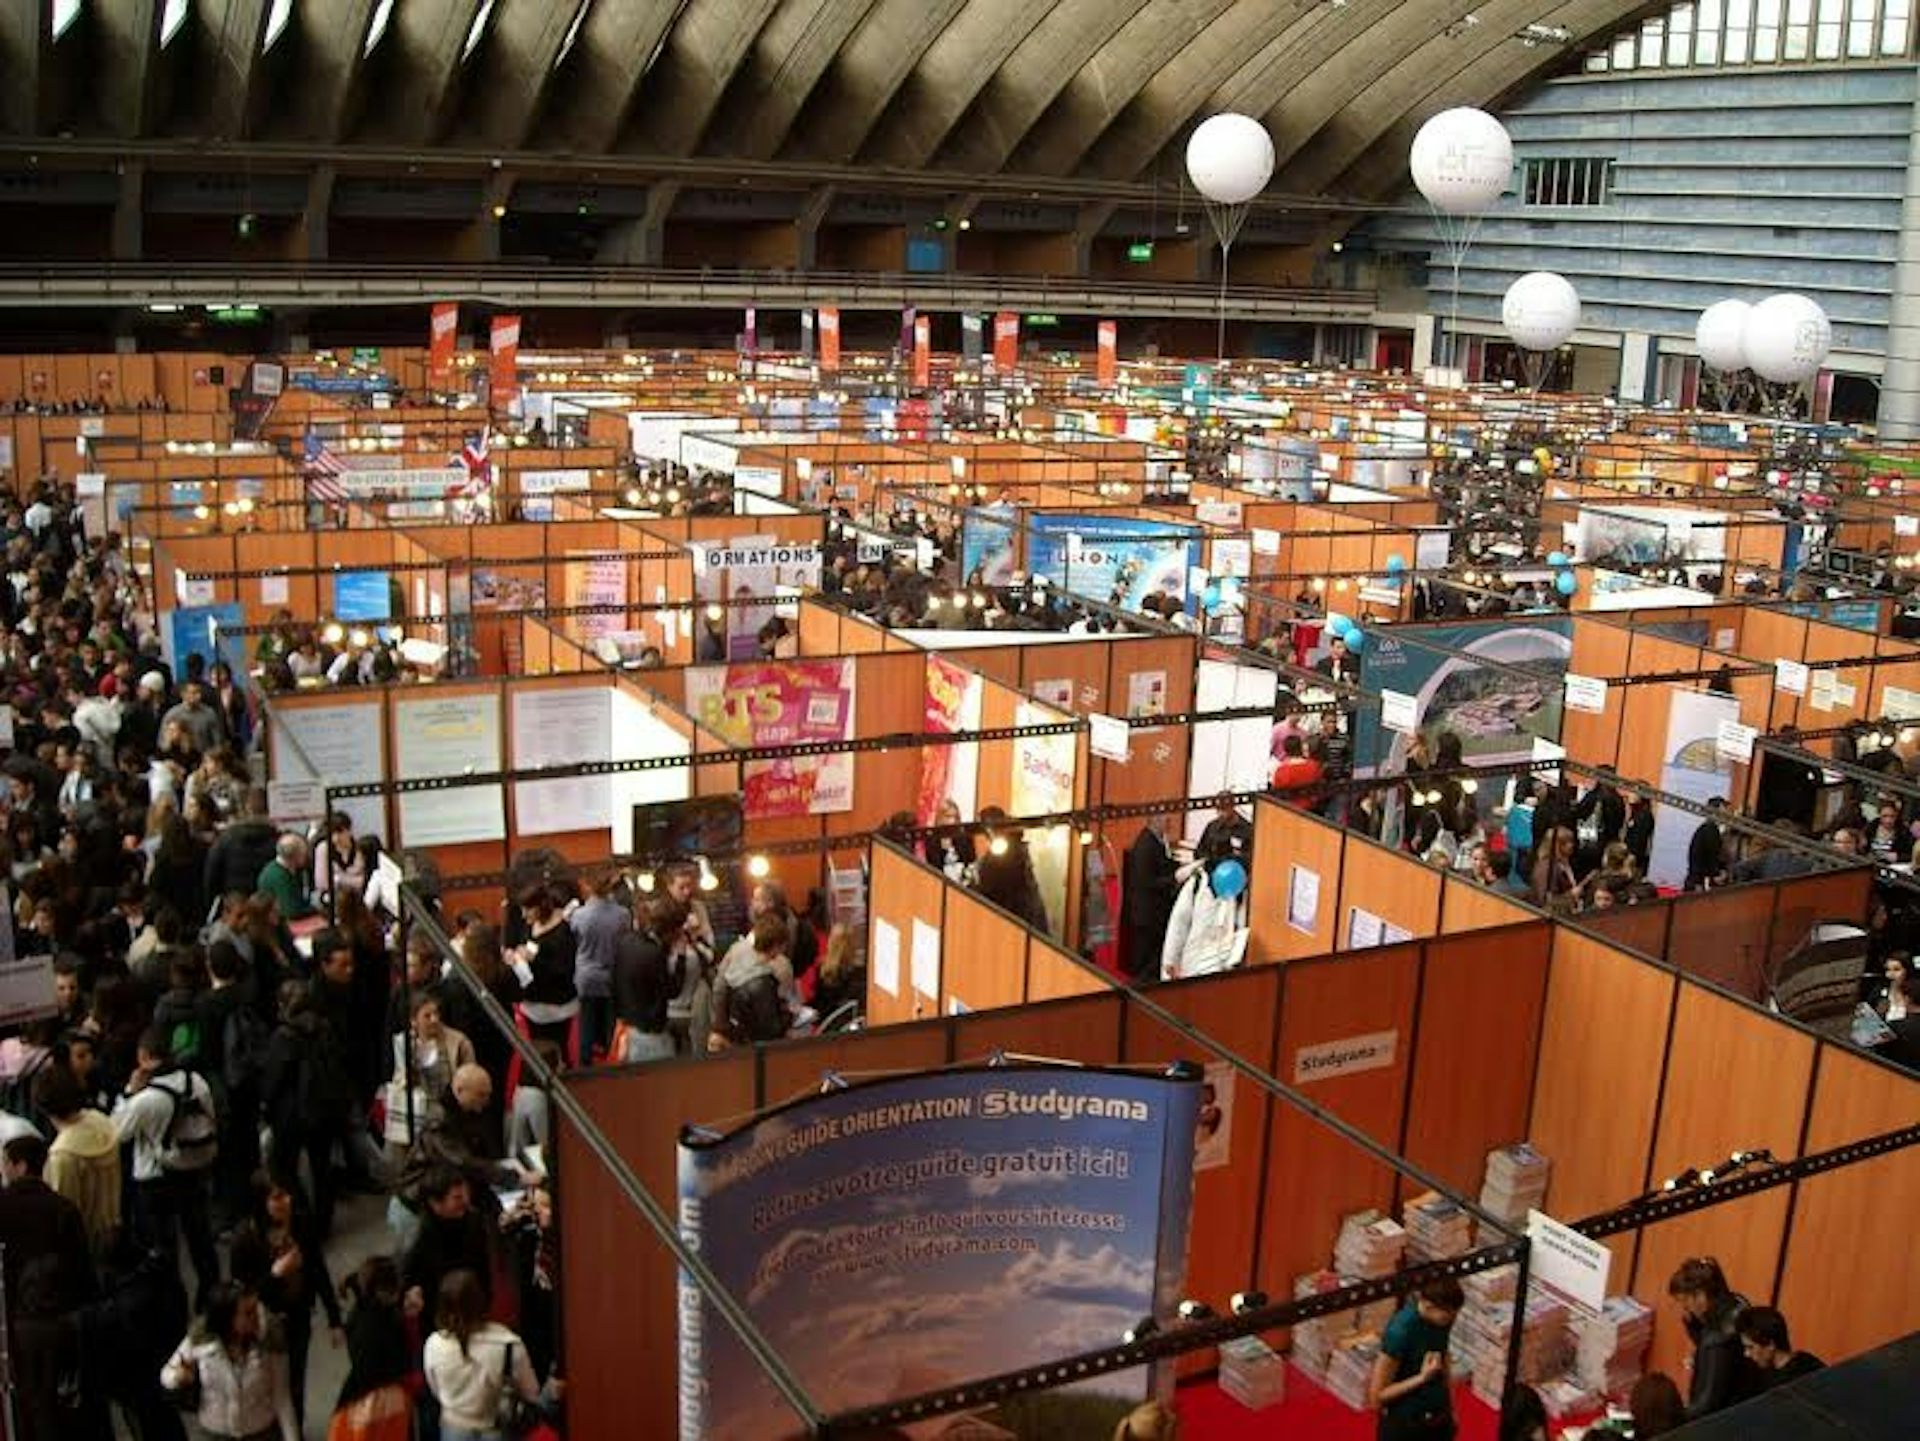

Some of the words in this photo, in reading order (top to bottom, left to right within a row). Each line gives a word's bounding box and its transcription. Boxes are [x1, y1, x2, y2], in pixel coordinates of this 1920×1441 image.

[701, 683, 783, 730] BTS
[1301, 1046, 1377, 1071] Studyrama
[787, 1118, 840, 1154] GUIDE
[842, 1096, 971, 1135] ORIENTATION
[980, 1087, 1149, 1121] Studyrama
[834, 1161, 900, 1198] votre
[904, 1149, 975, 1184] guide
[984, 1147, 1075, 1178] gratuit
[984, 1211, 1031, 1226] vous
